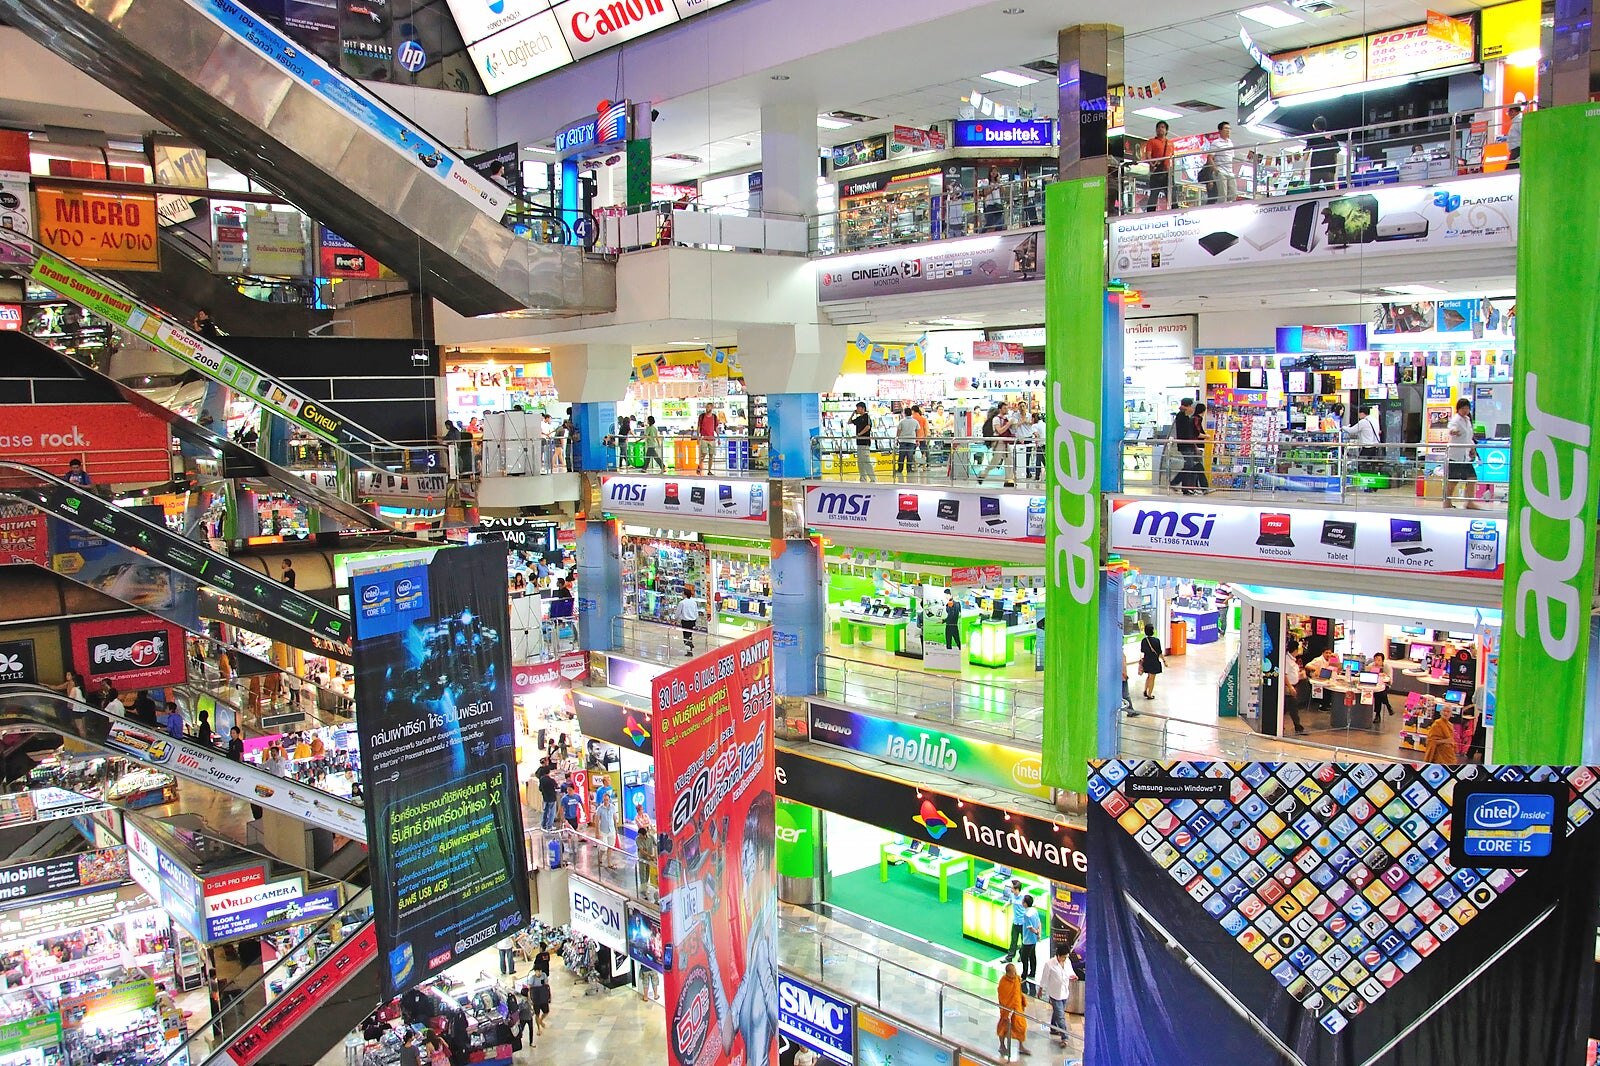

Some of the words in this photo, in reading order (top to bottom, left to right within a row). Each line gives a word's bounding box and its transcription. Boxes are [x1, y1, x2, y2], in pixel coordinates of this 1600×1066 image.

[343, 39, 357, 50] HIT
[360, 41, 393, 55] PRINT
[503, 33, 552, 68] Logitech
[401, 47, 423, 69] hp
[566, 122, 595, 147] CITY
[985, 127, 1040, 142] busitek
[453, 171, 468, 186] true
[849, 181, 879, 197] Kingston
[1259, 205, 1292, 215] PORTABLE
[1434, 190, 1461, 213] 3D
[1462, 194, 1514, 207] PLAYBACK
[56, 199, 140, 227] MICRO
[576, 220, 586, 237] 4
[45, 228, 83, 247] VDO
[851, 263, 899, 281] CINEMA
[900, 258, 921, 279] 3D
[832, 274, 842, 284] LG
[873, 278, 900, 288] MONITOR
[39, 264, 70, 285] Brand
[69, 277, 103, 300] Survey
[101, 293, 133, 314] Award
[1438, 301, 1461, 309] Perfect
[193, 351, 219, 371] 2008
[41, 426, 91, 448] rock.
[428, 455, 436, 468] 3
[611, 482, 648, 502] msi
[1053, 381, 1095, 605] acer
[60, 503, 80, 516] NVIDIA
[817, 492, 871, 516] msi
[828, 514, 848, 522] EST.1986
[899, 520, 919, 529] Notebook
[1132, 510, 1218, 540] msi
[1516, 371, 1591, 662] acer
[941, 523, 955, 531] Tablet
[977, 526, 985, 534] All
[990, 528, 1000, 536] One
[1001, 528, 1008, 536] PC
[502, 530, 526, 545] VAIO
[1150, 536, 1180, 545] EST.1986
[1182, 538, 1210, 547] TAIWAN
[1259, 546, 1292, 557] Notebook
[1327, 551, 1349, 561] Tablet
[1470, 542, 1494, 554] Visibly
[1470, 551, 1491, 560] Smart
[1386, 555, 1396, 565] All
[1398, 557, 1403, 565] In
[1405, 558, 1421, 567] One
[1423, 558, 1434, 567] PC
[366, 608, 380, 617] CORE
[399, 602, 412, 610] CORE
[324, 626, 340, 637] NVIDIA
[1201, 624, 1217, 632] SAMSUNG
[95, 636, 166, 665] Freejet
[740, 639, 770, 668] PANTIP
[659, 687, 670, 711] 30
[718, 654, 735, 679] 2555
[743, 676, 771, 704] SALE
[743, 692, 772, 722] 2012
[661, 717, 670, 733] @
[814, 718, 852, 736] lenovo
[114, 735, 148, 752] SUPER
[149, 741, 168, 759] 4
[180, 746, 214, 763] GIGABYTE
[176, 753, 200, 770] Win
[207, 767, 241, 786] Super4
[1016, 763, 1042, 780] intel
[1133, 783, 1164, 795] Samsung
[1479, 803, 1512, 820] intel
[1520, 811, 1548, 823] inside
[962, 816, 1088, 872] hardware
[1478, 840, 1513, 853] CORE
[1519, 840, 1532, 853] i5
[0, 867, 46, 884] Mobile
[159, 854, 190, 891] GIGABYTE
[207, 879, 227, 890] D-SLR
[228, 877, 241, 886] PRO
[242, 873, 262, 882] SPACE
[211, 896, 252, 912] WORLD
[253, 885, 298, 902] CAMERA
[418, 885, 433, 901] USB
[574, 891, 621, 932] EPSON
[682, 893, 697, 920] Like
[212, 916, 235, 925] FLOOR
[212, 923, 229, 932] NEAR
[230, 918, 251, 929] TOILET
[464, 922, 498, 949] SYNNEX
[81, 952, 121, 967] WORLD
[430, 951, 452, 968] MICRO
[779, 981, 844, 1036] SMC
[780, 1013, 844, 1052] Networks
